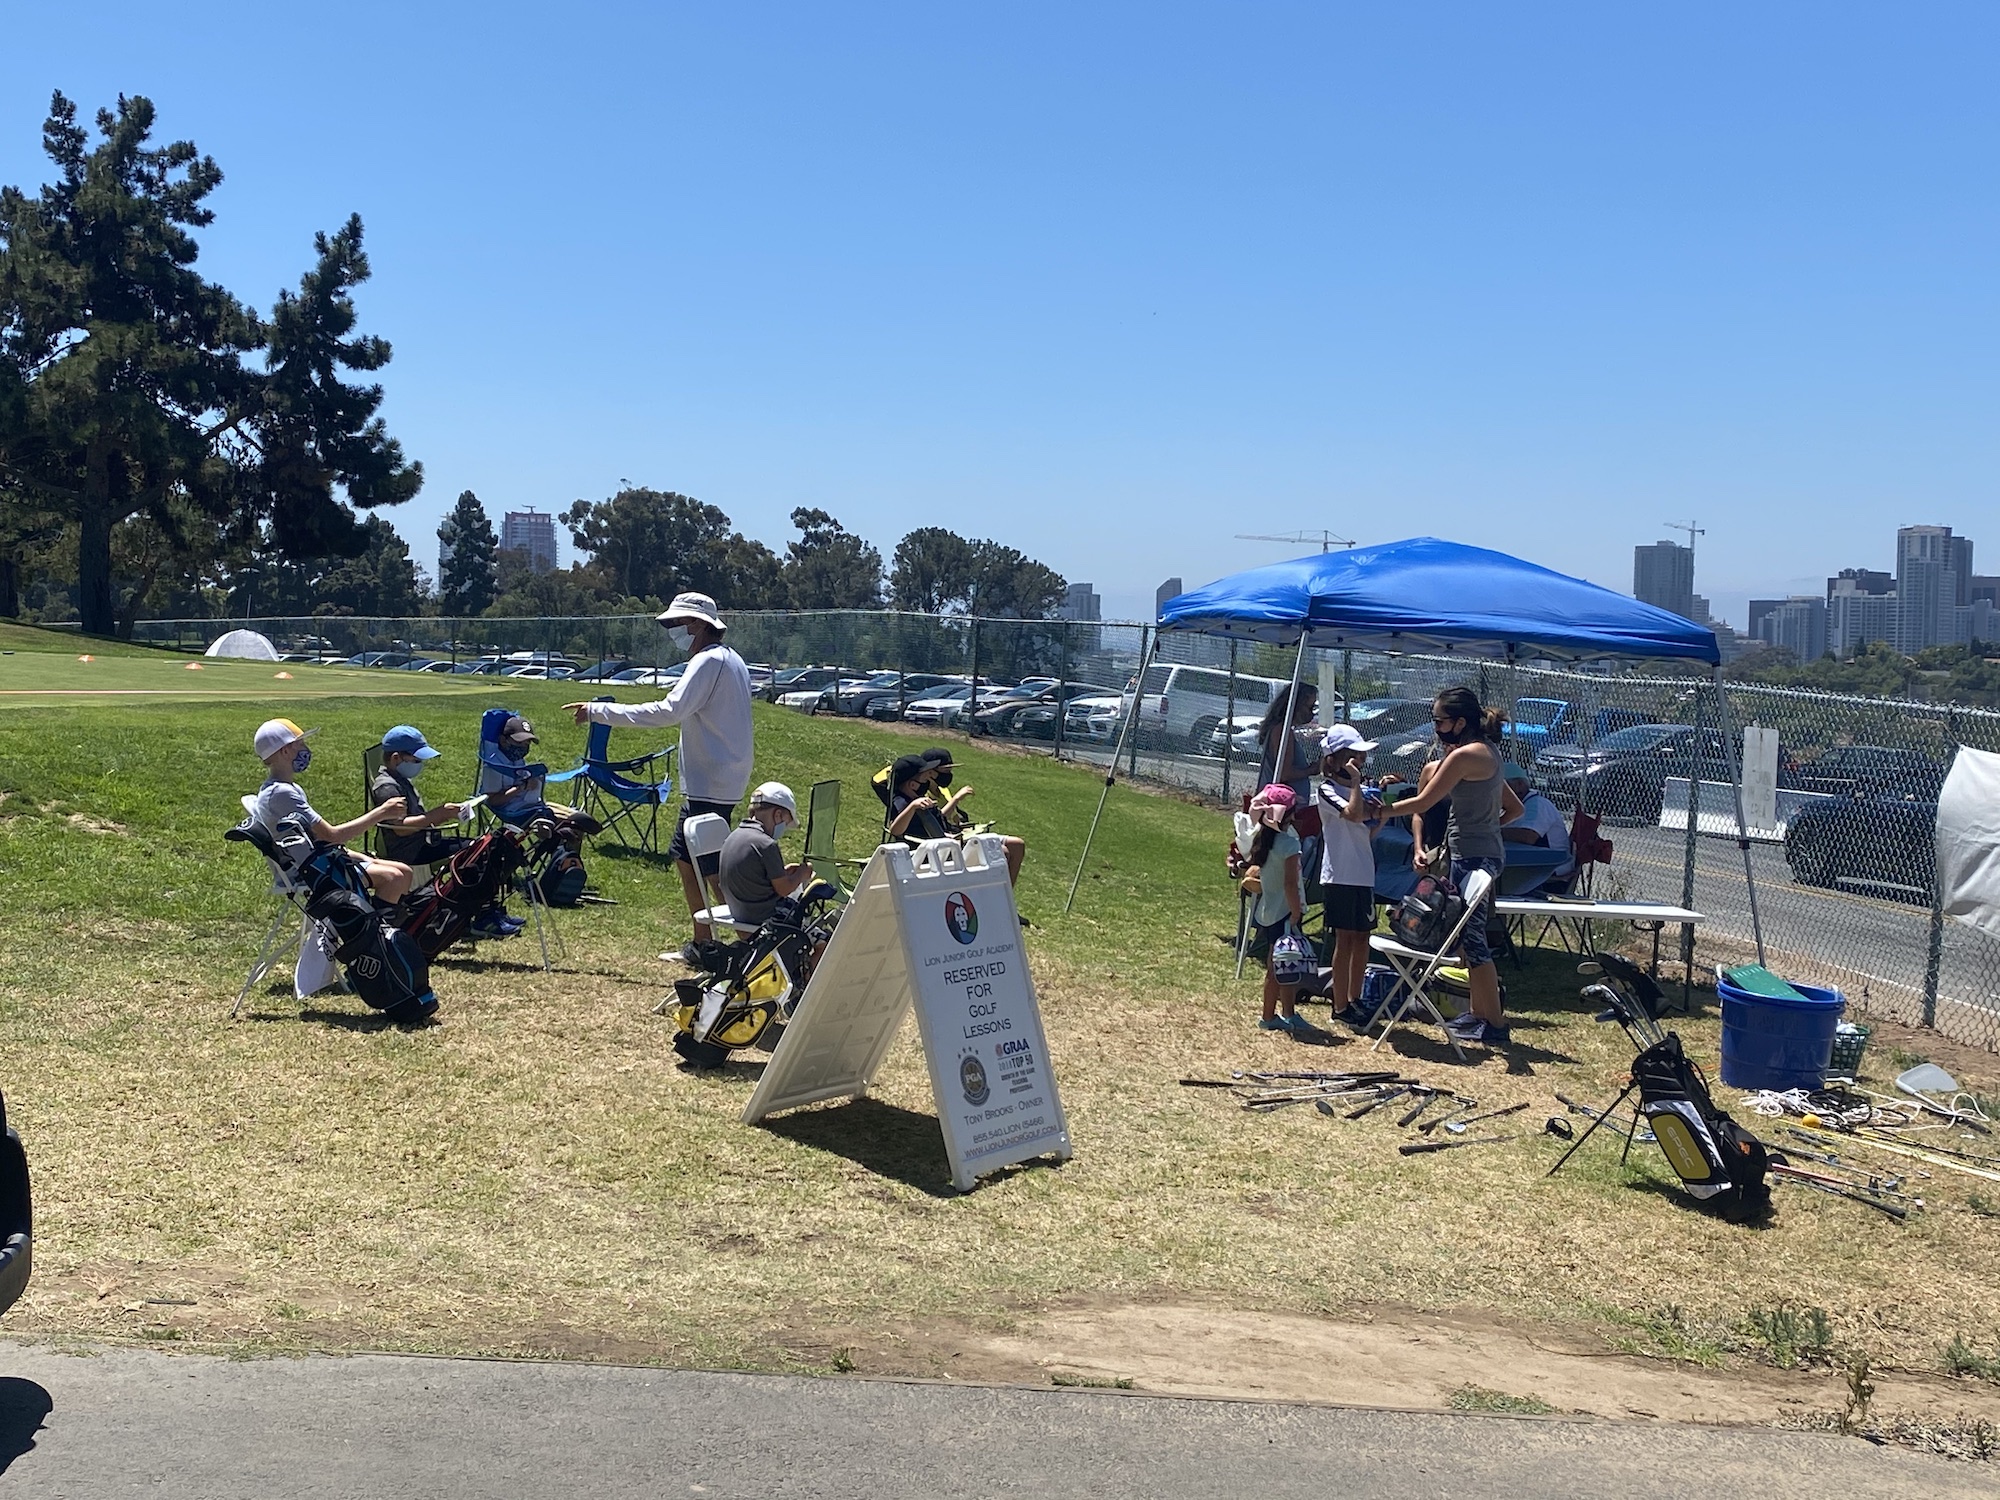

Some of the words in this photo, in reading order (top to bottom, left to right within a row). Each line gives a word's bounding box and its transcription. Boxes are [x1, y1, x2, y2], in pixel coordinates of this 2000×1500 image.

[924, 956, 941, 967] LION
[942, 952, 966, 964] JUNIOR
[966, 948, 984, 960] GOLF
[986, 944, 1014, 955] ACADEMY
[943, 961, 1006, 985] RESERVED
[966, 983, 993, 1000] FOR
[968, 1002, 998, 1018] GOLF
[962, 1018, 1012, 1039] LESSONS
[1003, 1038, 1030, 1055] GRAA
[1011, 1055, 1024, 1069] TOP
[1025, 1053, 1034, 1066] 50
[965, 1072, 983, 1084] PGA
[963, 1114, 983, 1126] TONY
[985, 1105, 1014, 1120] BROOKS
[1018, 1096, 1044, 1111] OWNER
